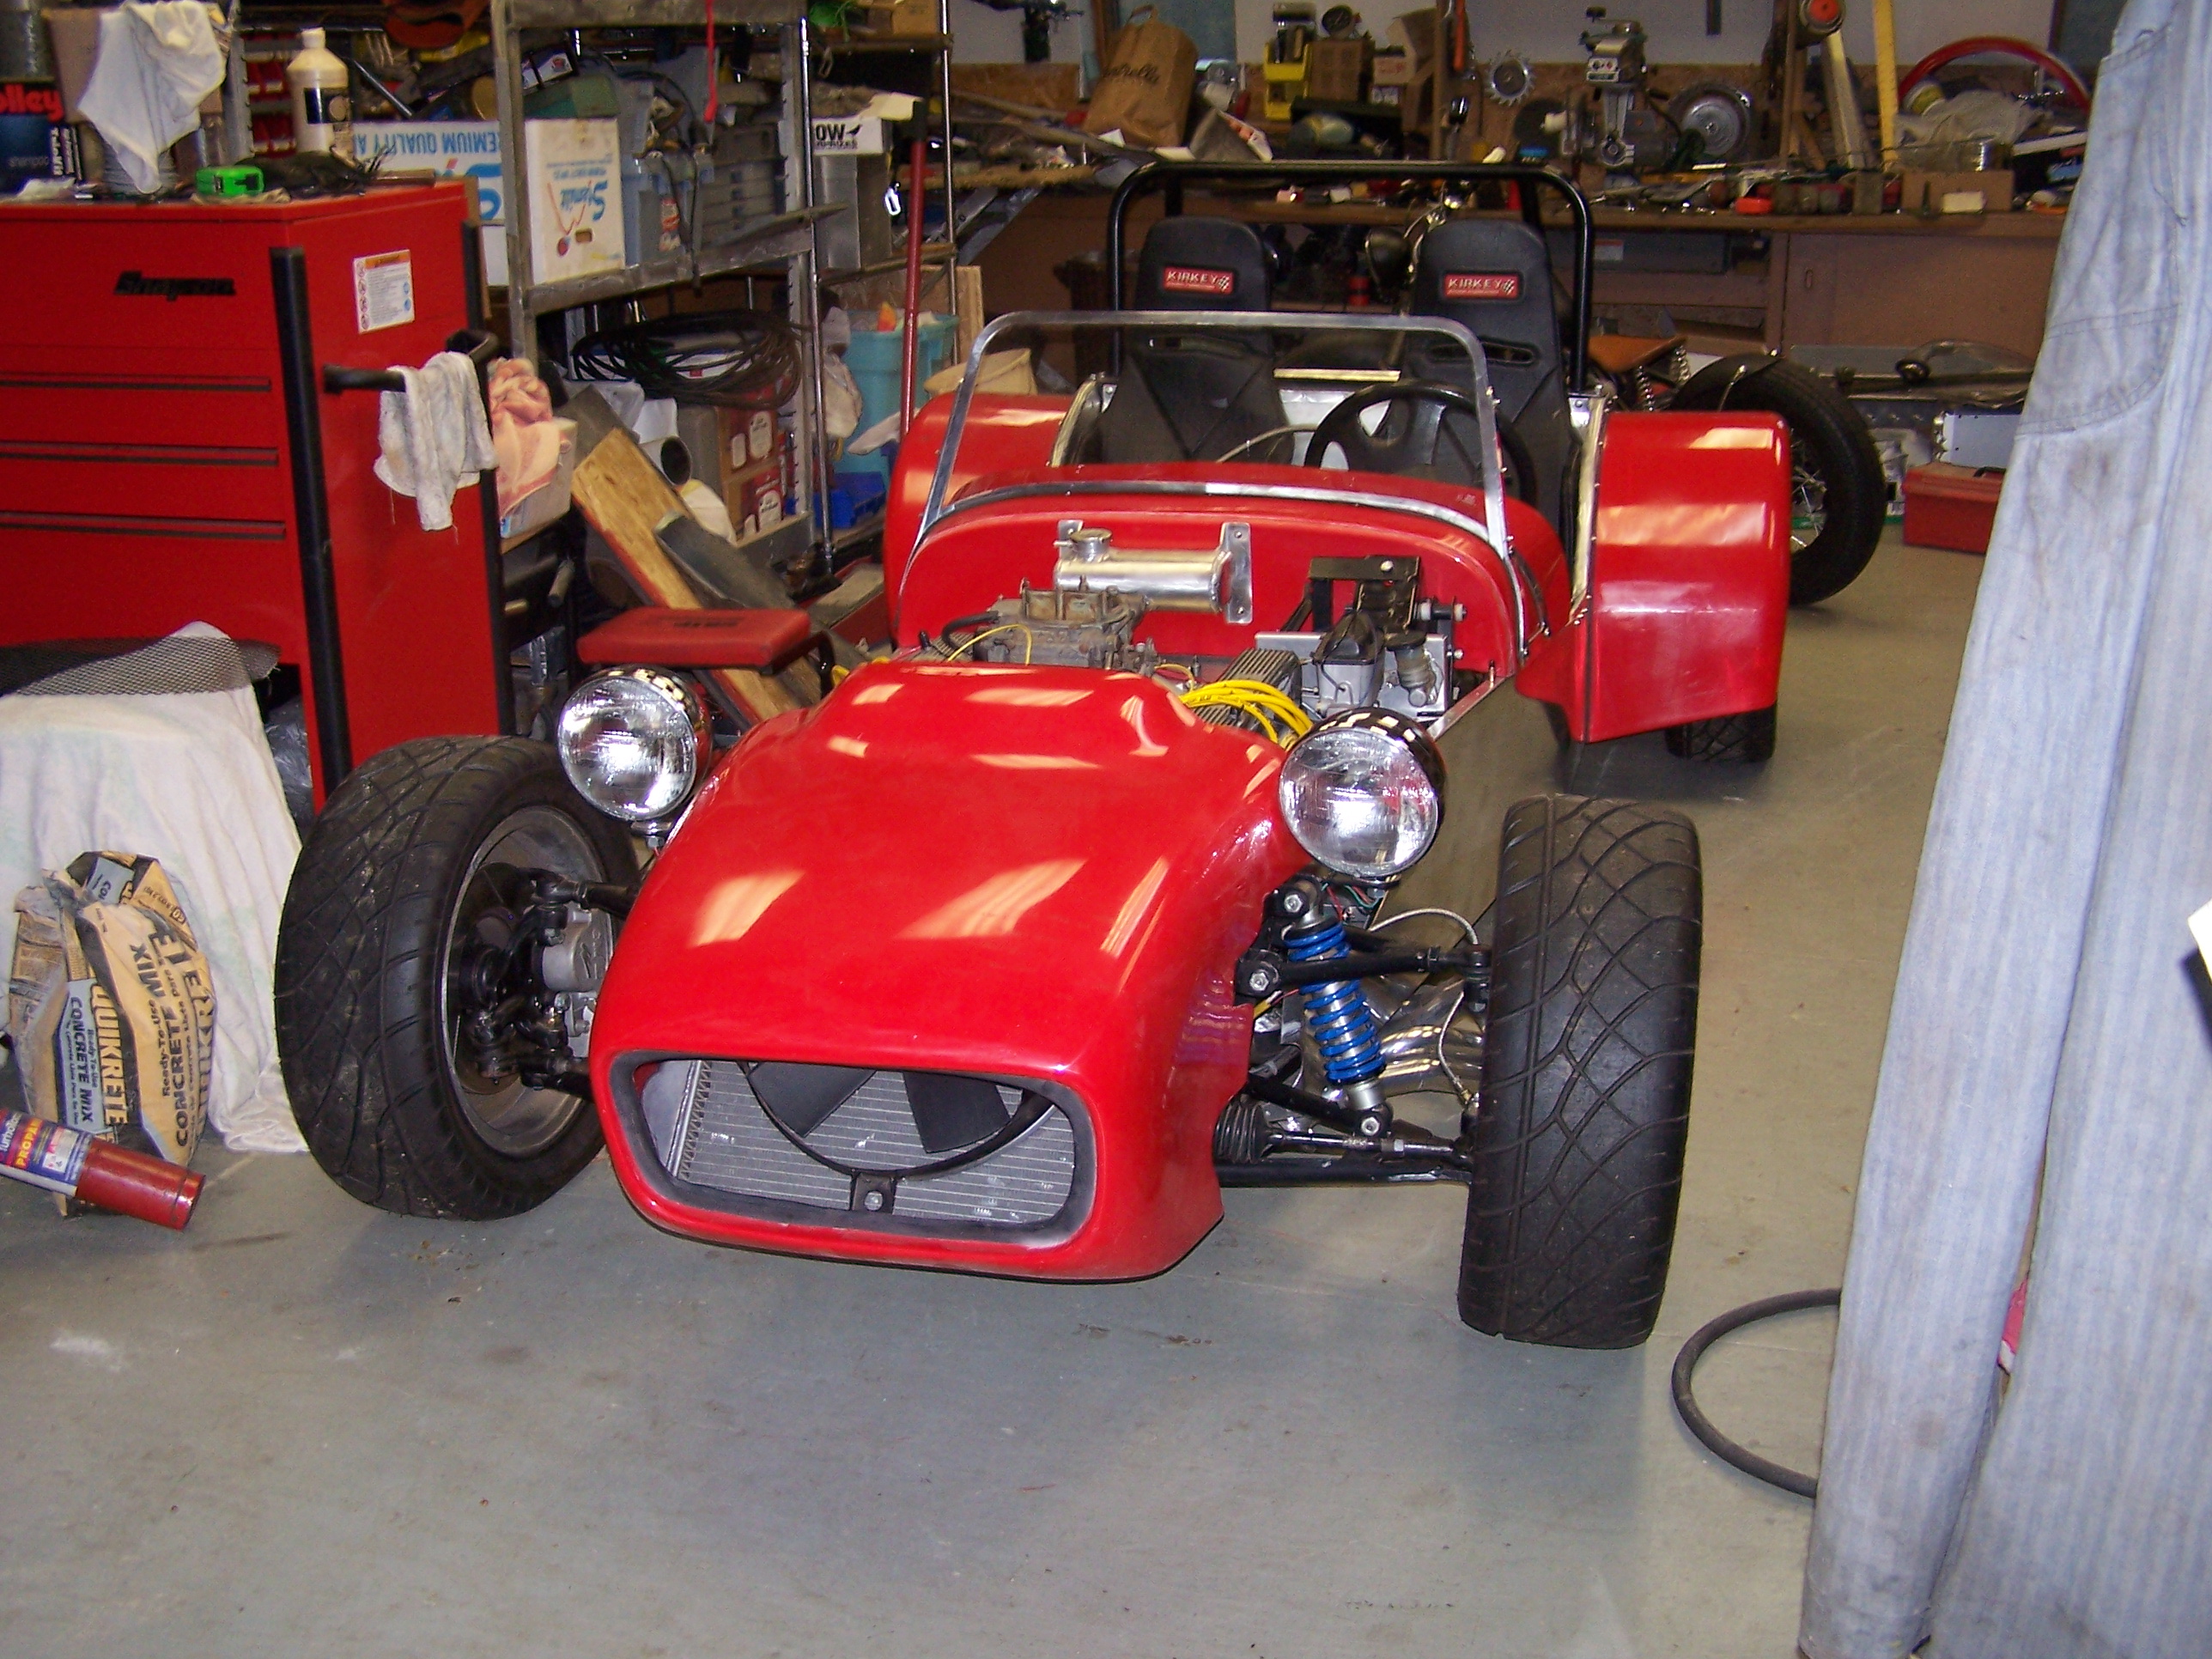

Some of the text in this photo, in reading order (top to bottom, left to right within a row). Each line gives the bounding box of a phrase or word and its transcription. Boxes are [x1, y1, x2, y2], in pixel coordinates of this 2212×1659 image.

[372, 131, 437, 155] QUALITY
[1166, 270, 1218, 284] KIRKEY
[1448, 278, 1502, 290] KIRKEY
[70, 996, 94, 1122] CONCRETE MIX
[91, 985, 128, 1124] QUIKRETE
[131, 944, 190, 1147] CONCRETE MIX
[149, 999, 171, 1097] Ready-To-Use
